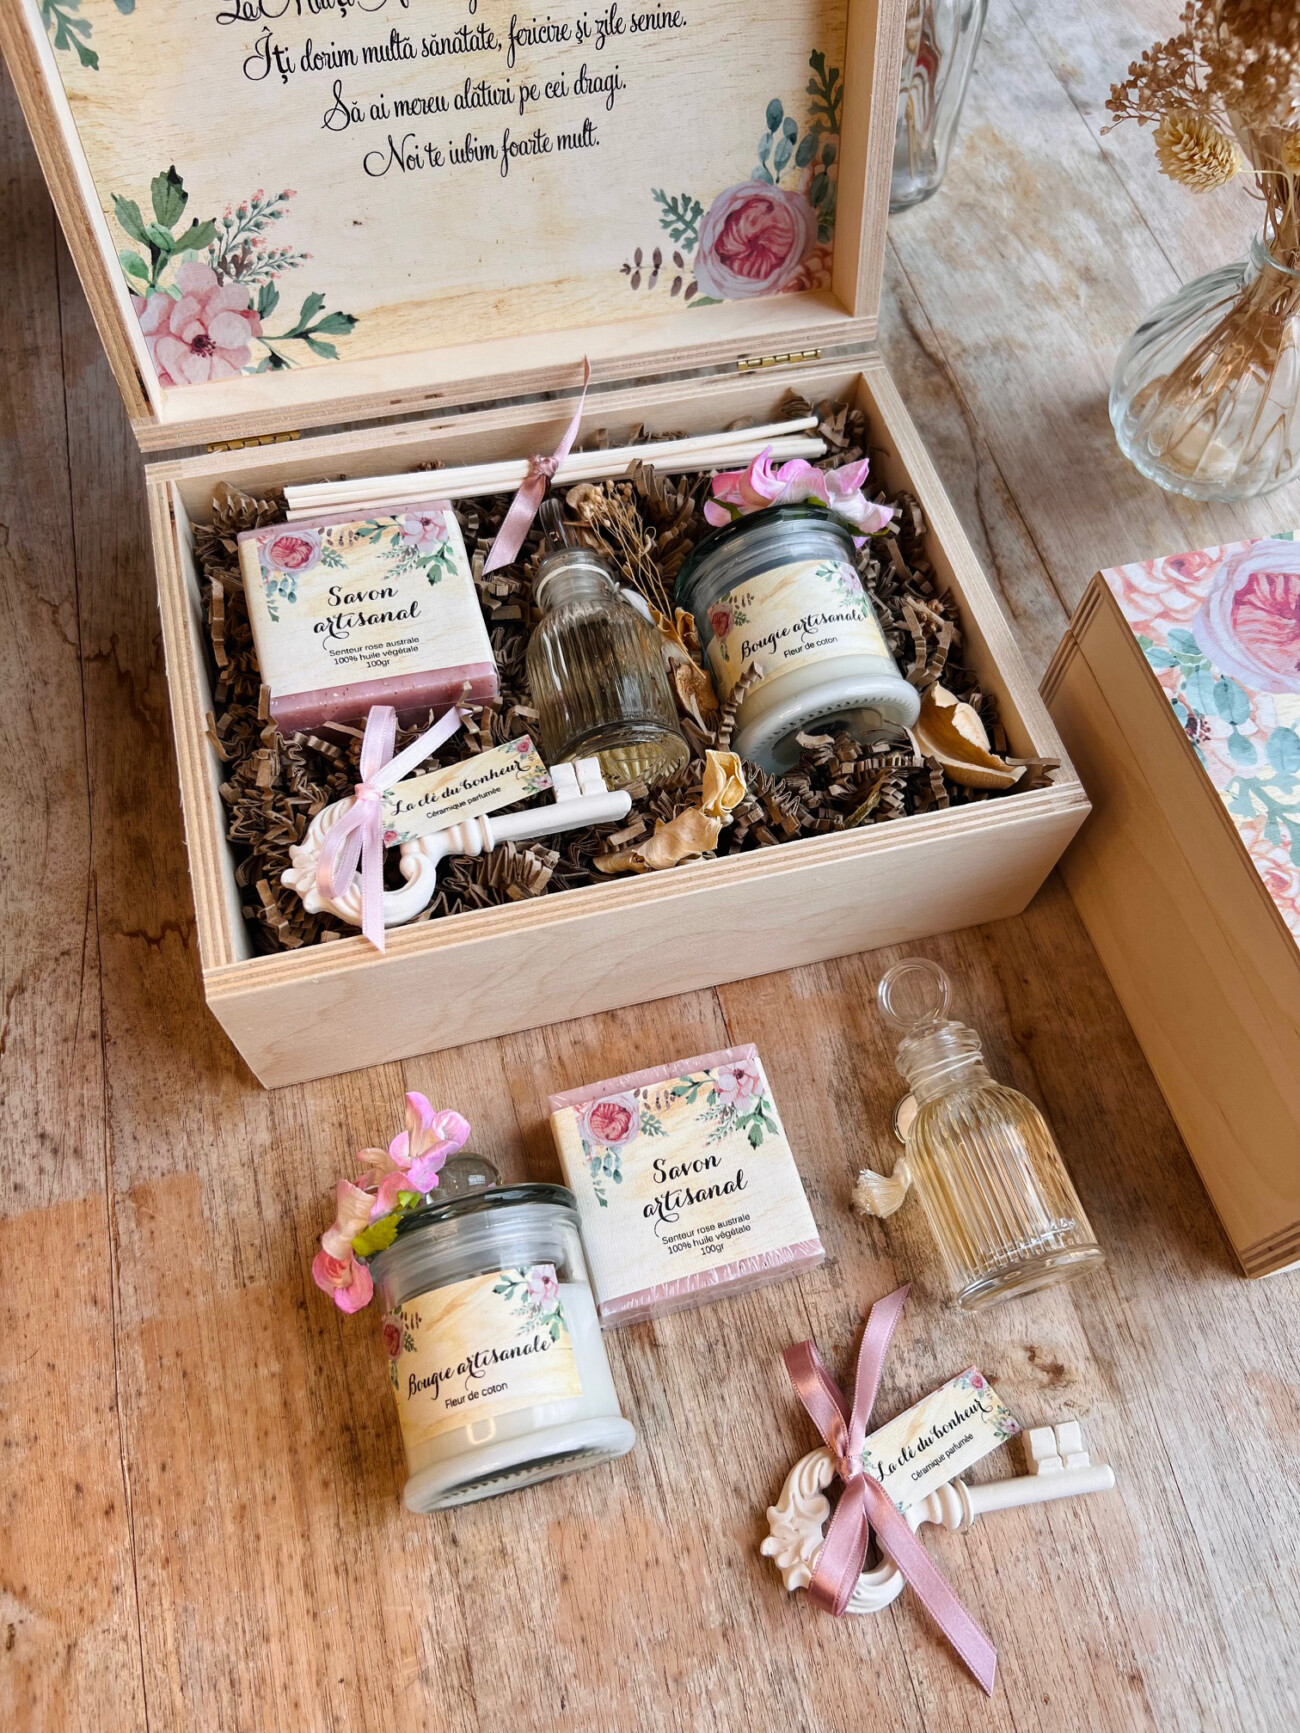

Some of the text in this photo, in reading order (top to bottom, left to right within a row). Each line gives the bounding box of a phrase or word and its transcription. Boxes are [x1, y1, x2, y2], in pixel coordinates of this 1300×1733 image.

[300, 38, 358, 72] dorim
[363, 28, 416, 64] multă
[421, 23, 502, 57] sănătate,
[507, 14, 572, 68] fericire
[595, 2, 626, 50] zile
[629, 3, 687, 33] senine.
[320, 64, 627, 131] Să ai mereu alături pe cei dragi.
[363, 118, 600, 177] Noi te iubim foarte mult.
[328, 586, 398, 606] Savon
[314, 600, 421, 650] artisanal
[741, 609, 864, 664] Bougie artisanale
[329, 637, 420, 657] Senteur rose australe
[334, 645, 419, 665] 100% huile végétale
[366, 659, 391, 668] 100gr
[783, 636, 838, 659] Fleur de coton
[390, 760, 532, 816] La clé du bonheur
[426, 786, 501, 819] Céramique parfumée
[653, 1155, 722, 1183] Savon
[643, 1169, 748, 1237] artisanal
[662, 1213, 751, 1245] Senteur rose australe
[668, 1223, 751, 1255] 100% huile végétale
[700, 1242, 724, 1256] 100gr
[408, 1335, 551, 1401] Bougie artisanale
[445, 1382, 508, 1409] Fleur de coton
[876, 1398, 993, 1482] La clé du bonheur
[911, 1432, 974, 1481] Céramique parfumée
